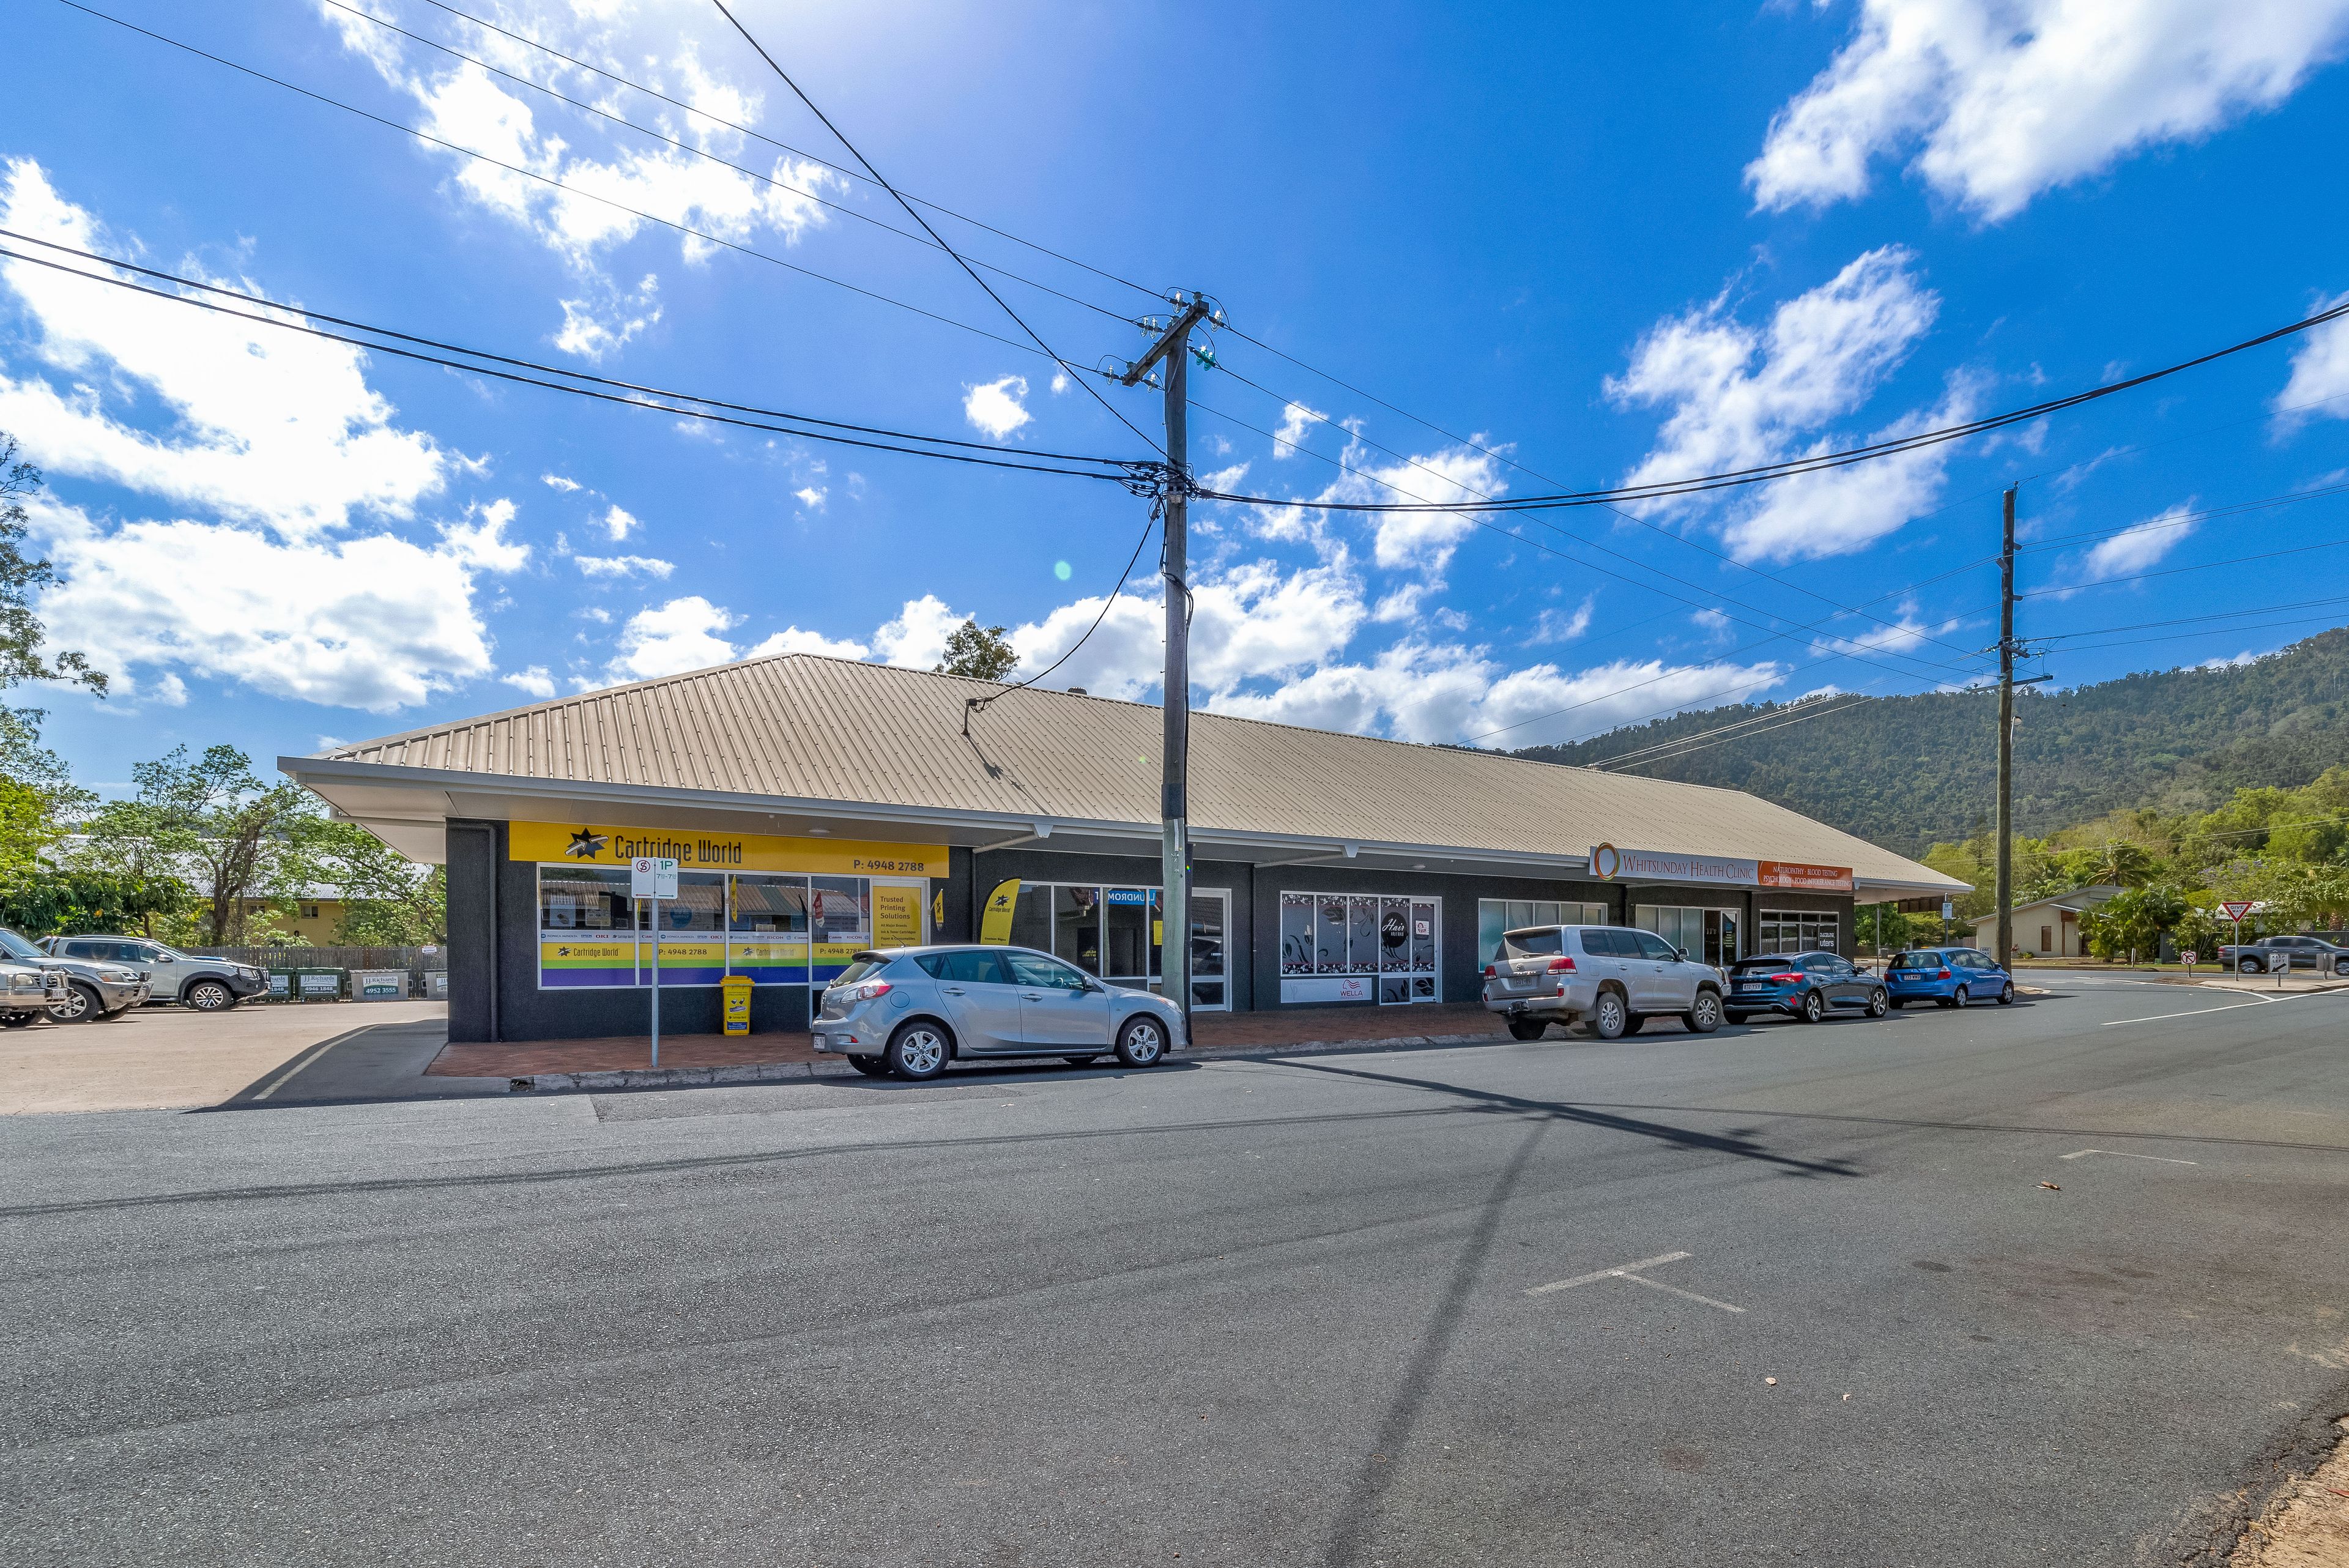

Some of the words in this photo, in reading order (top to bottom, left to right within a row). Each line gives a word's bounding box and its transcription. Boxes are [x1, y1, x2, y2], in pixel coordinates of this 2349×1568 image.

[615, 836, 691, 866] Cartridge
[699, 839, 742, 864] World
[660, 860, 674, 870] 1P
[853, 860, 864, 869] P:
[867, 860, 894, 871] 4948
[898, 861, 924, 872] 2788
[1623, 855, 1688, 875] WHITSUNDAY
[1691, 861, 1724, 877] HEALTH
[1726, 864, 1754, 879] CLINIC
[1773, 866, 1805, 875] NATUROPATHY
[1763, 875, 1792, 883] PSYCHOLOGY
[1382, 918, 1405, 931] Hair
[573, 948, 601, 958] Cartridge
